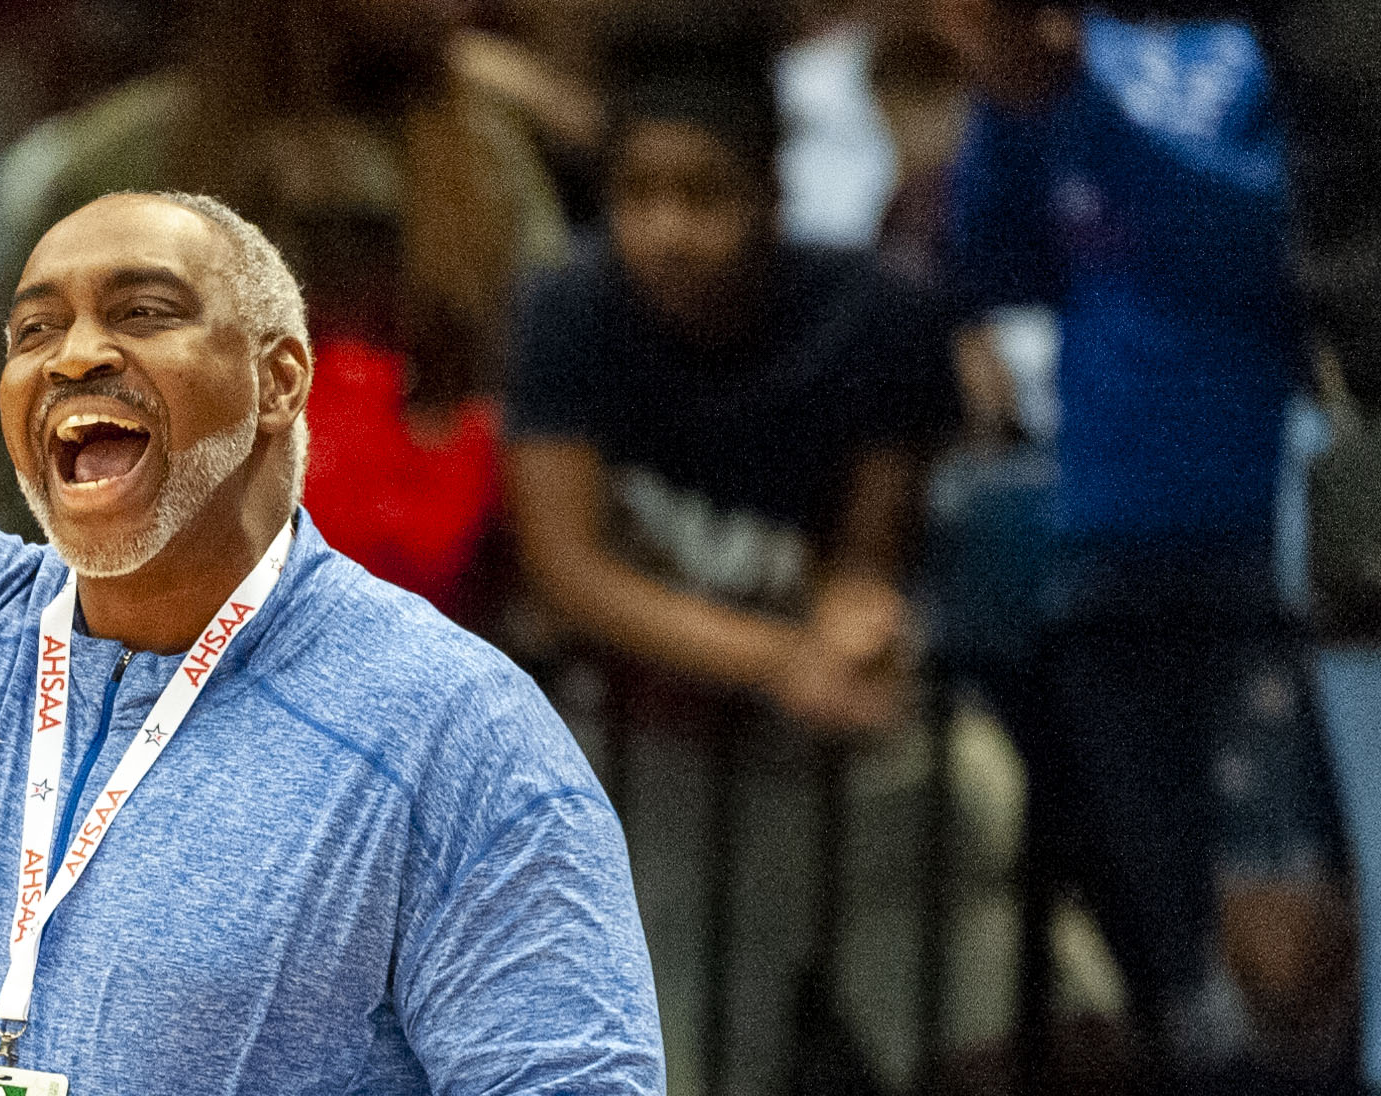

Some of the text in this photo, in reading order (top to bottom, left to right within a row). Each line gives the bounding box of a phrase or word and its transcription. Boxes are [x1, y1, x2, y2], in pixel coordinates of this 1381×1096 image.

[38, 634, 66, 733] AHSAA
[183, 602, 256, 688] AHSAA
[65, 789, 128, 878] AHSAA
